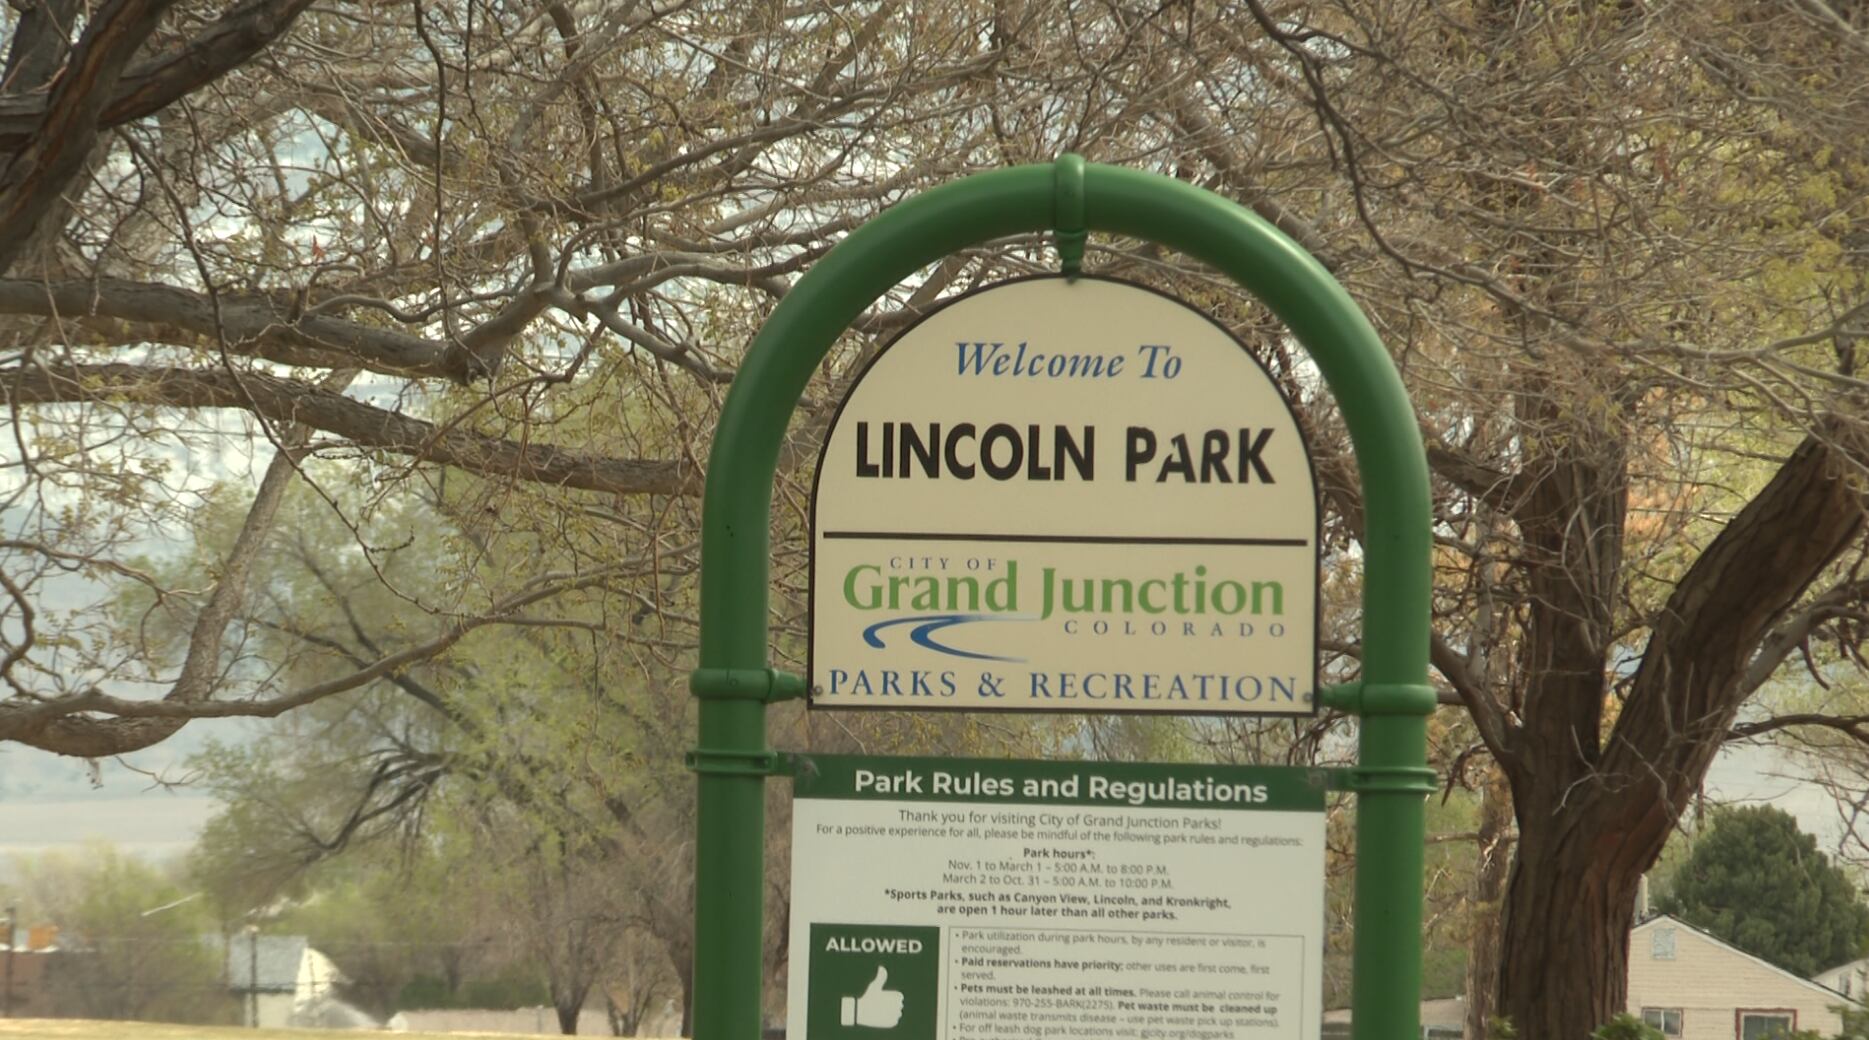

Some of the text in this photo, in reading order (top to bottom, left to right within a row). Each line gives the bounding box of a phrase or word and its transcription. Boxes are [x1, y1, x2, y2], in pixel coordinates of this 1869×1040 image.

[955, 342, 1182, 380] Welcome To
[856, 421, 1275, 484] LINCOLN PARK
[890, 556, 997, 571] CITY OF
[842, 560, 1284, 620] Grand Junction
[1064, 620, 1284, 637] COLORADO
[828, 669, 1296, 701] PARKS & RECREATION
[854, 769, 1268, 805] Park Rules and Regulations
[899, 810, 1221, 830] Thank you for visiting City of Grand Junction Parks!
[816, 824, 1303, 847] For a positive experience for all, please be mindful of the following park rules and regulations:
[1023, 848, 1050, 858] Park
[948, 860, 973, 870] Nov.
[976, 861, 981, 870] 1
[985, 862, 996, 870] to
[999, 861, 1033, 871] March
[1037, 862, 1042, 871] 1
[1054, 863, 1077, 873] 5:00
[1080, 864, 1103, 873] A.M.
[1106, 865, 1118, 874] to
[1120, 865, 1143, 874] 8:00
[1146, 865, 1169, 875] P.M.
[943, 873, 976, 884] March
[980, 875, 986, 884] 2
[989, 876, 1001, 885] to
[1003, 875, 1025, 886] Oct.
[1028, 876, 1040, 886] 31
[1053, 877, 1076, 887] 5:00
[1078, 877, 1102, 887] A.M.
[1105, 879, 1116, 888] to
[1120, 879, 1148, 888] 10:00
[1151, 879, 1174, 889] P.M.
[930, 890, 965, 902] Parks,
[969, 891, 995, 902] such
[998, 894, 1011, 902] as
[1014, 893, 1057, 904] Canyon
[1059, 894, 1090, 905] View,
[1093, 895, 1138, 906] Lincoln,
[1141, 896, 1162, 906] and
[1166, 896, 1231, 910] Kronkright,
[937, 905, 1177, 921] are open 1 hour later than all other parks.
[826, 937, 923, 954] ALLOWED
[963, 931, 984, 939] Park
[987, 932, 1036, 941] utilization
[1038, 933, 1070, 944] during
[1072, 933, 1095, 944] park
[1097, 934, 1130, 944] hours,
[1132, 936, 1142, 947] by
[1145, 938, 1163, 947] any
[1166, 937, 1206, 946] resident
[1222, 939, 1255, 948] visitor,
[1258, 939, 1266, 948] is
[962, 945, 1022, 955] encouraged.
[962, 957, 984, 966] Paid
[987, 958, 1052, 968] reservations
[1054, 959, 1079, 968] have
[1082, 961, 1123, 971] priority;
[1126, 962, 1152, 971] other
[1198, 964, 1216, 973] first
[1219, 966, 1248, 974] come,
[1250, 965, 1270, 974] first
[961, 971, 996, 980] served.
[961, 984, 1280, 1001] Pets must be leashed at all times. Please call animal control for
[960, 998, 1009, 1006] violations:
[1118, 1002, 1135, 1010] Pet
[1138, 1003, 1169, 1011] waste
[1172, 1003, 1199, 1012] must
[1202, 1003, 1214, 1012] be
[1219, 1004, 1261, 1013] cleaned
[1264, 1006, 1277, 1015] up
[960, 1011, 996, 1020] (animal
[999, 1012, 1028, 1020] waste
[1030, 1012, 1078, 1021] transmits
[1079, 1012, 1117, 1022] disease
[1147, 1016, 1164, 1025] pet
[1197, 1016, 1217, 1027] pick
[1220, 1018, 1233, 1027] up
[960, 1023, 976, 1031] For
[978, 1023, 992, 1032] off
[995, 1024, 1020, 1032] leash
[1023, 1025, 1042, 1035] dog
[1044, 1026, 1066, 1035] park
[1069, 1026, 1113, 1036] locations
